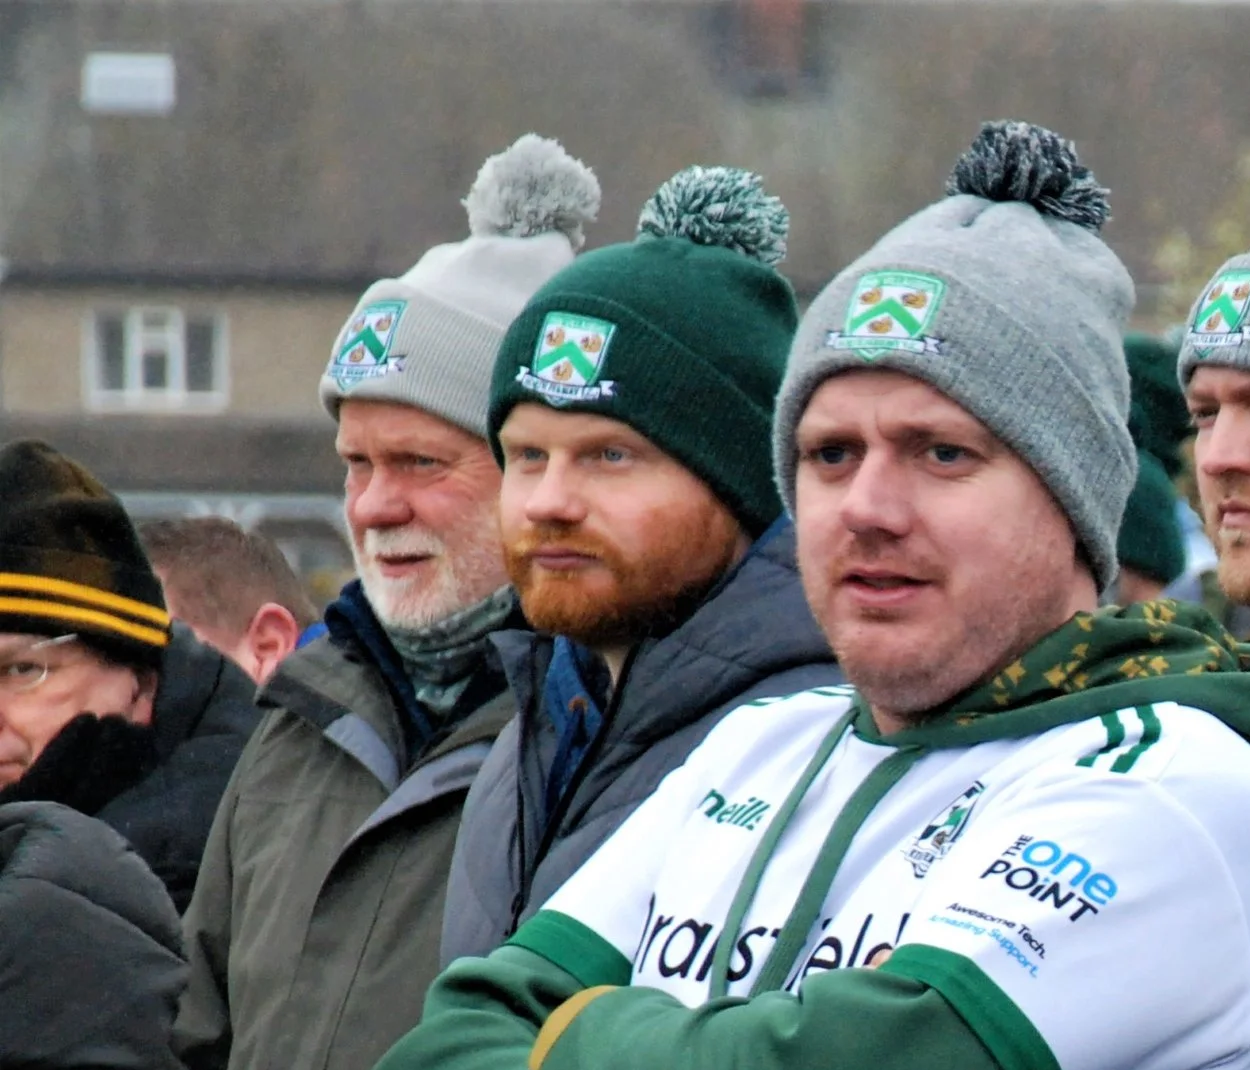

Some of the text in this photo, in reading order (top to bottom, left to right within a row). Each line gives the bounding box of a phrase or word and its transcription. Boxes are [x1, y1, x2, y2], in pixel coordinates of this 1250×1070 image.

[1002, 834, 1034, 857] THE
[1021, 840, 1118, 906] one
[946, 902, 1047, 960] Awesome Tech.
